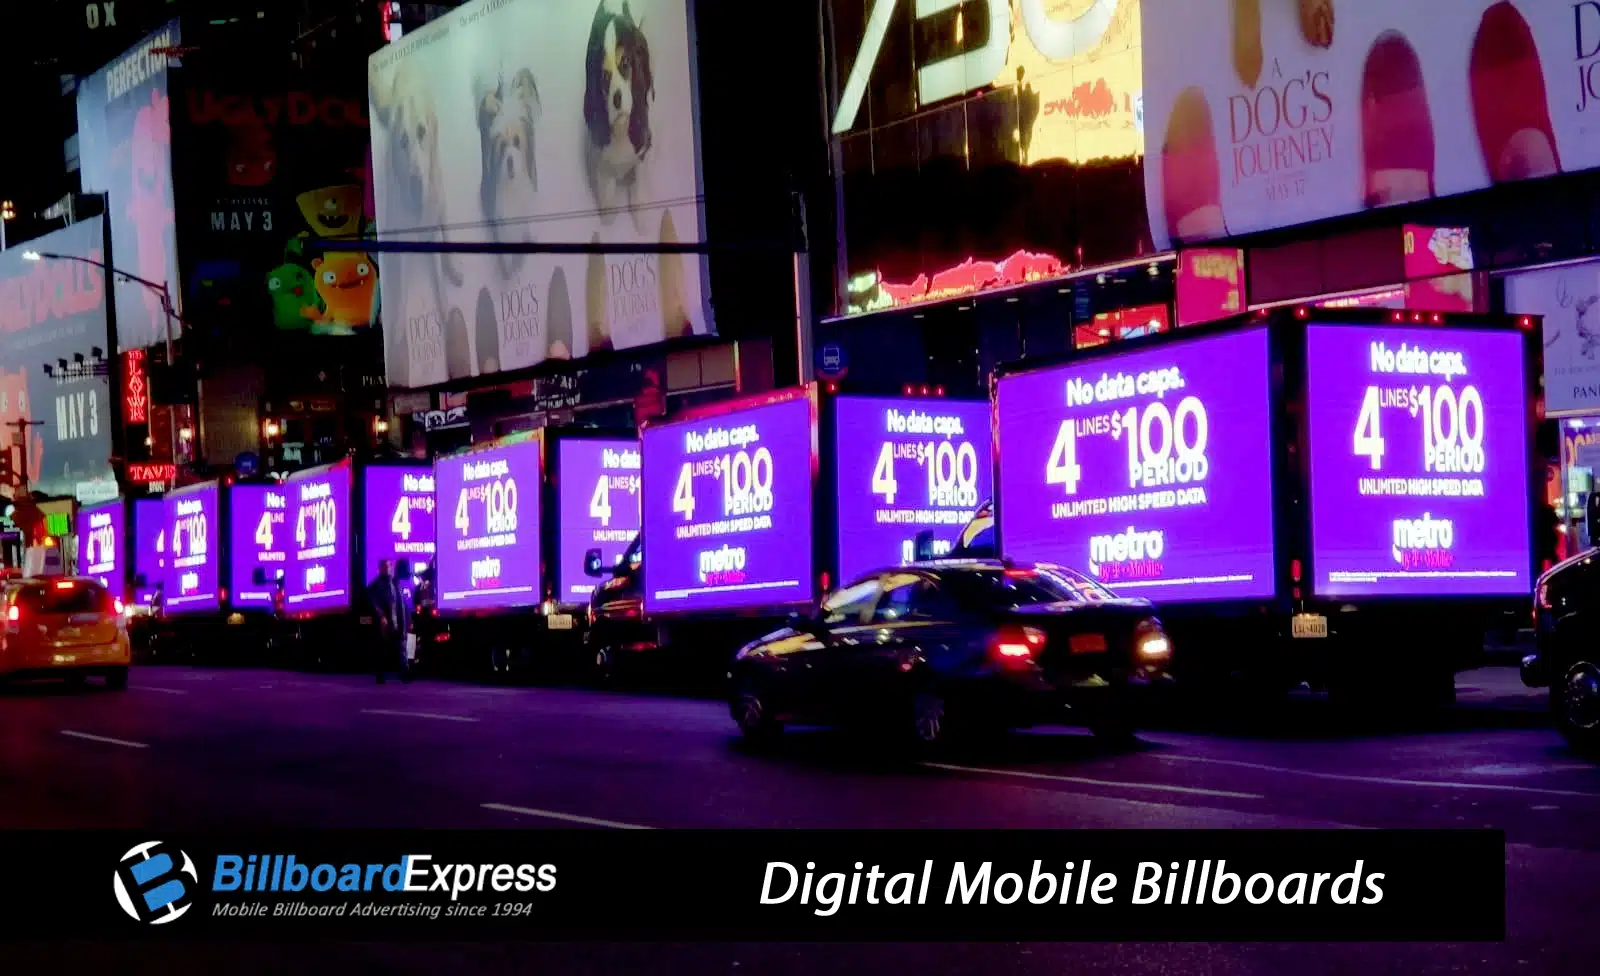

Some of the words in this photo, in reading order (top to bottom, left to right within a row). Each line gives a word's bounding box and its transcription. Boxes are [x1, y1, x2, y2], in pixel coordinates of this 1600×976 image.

[1271, 58, 1282, 78] A
[1228, 71, 1333, 144] DOG'S
[1232, 126, 1334, 187] JOURNEY
[210, 211, 253, 232] MAY
[262, 211, 273, 231] 3
[500, 283, 539, 321] DOG'S
[1371, 341, 1394, 372] No
[1395, 344, 1428, 374] data
[1066, 378, 1093, 407] No
[1095, 372, 1134, 402] data
[1137, 366, 1185, 398] caps.
[56, 391, 84, 441] MAY
[89, 388, 98, 436] 3
[887, 409, 905, 432] No
[907, 410, 933, 433] data
[1353, 386, 1384, 469] 4
[1380, 389, 1408, 408] LINES
[603, 449, 620, 468] No
[686, 431, 703, 453] No
[705, 428, 729, 448] data
[1046, 420, 1081, 494] 4
[1076, 415, 1110, 437] LINES
[1425, 446, 1485, 472] PERIOD
[872, 442, 897, 504] 4
[893, 443, 917, 458] LINES
[1130, 453, 1208, 488] PERIOD
[1360, 478, 1407, 495] UNLIMITED
[590, 475, 611, 526] 4
[673, 462, 695, 520] 4
[692, 462, 714, 477] LINES
[725, 493, 773, 516] PERIOD
[929, 487, 977, 507] PERIOD
[1052, 499, 1106, 518] UNLIMITED
[1108, 495, 1137, 512] HIGH
[1138, 490, 1175, 509] SPEED
[256, 512, 273, 550] 4
[391, 496, 411, 540] 4
[454, 488, 469, 536] 4
[677, 524, 711, 539] UNLIMITED
[1393, 512, 1452, 564] metro
[1089, 526, 1164, 576] metro
